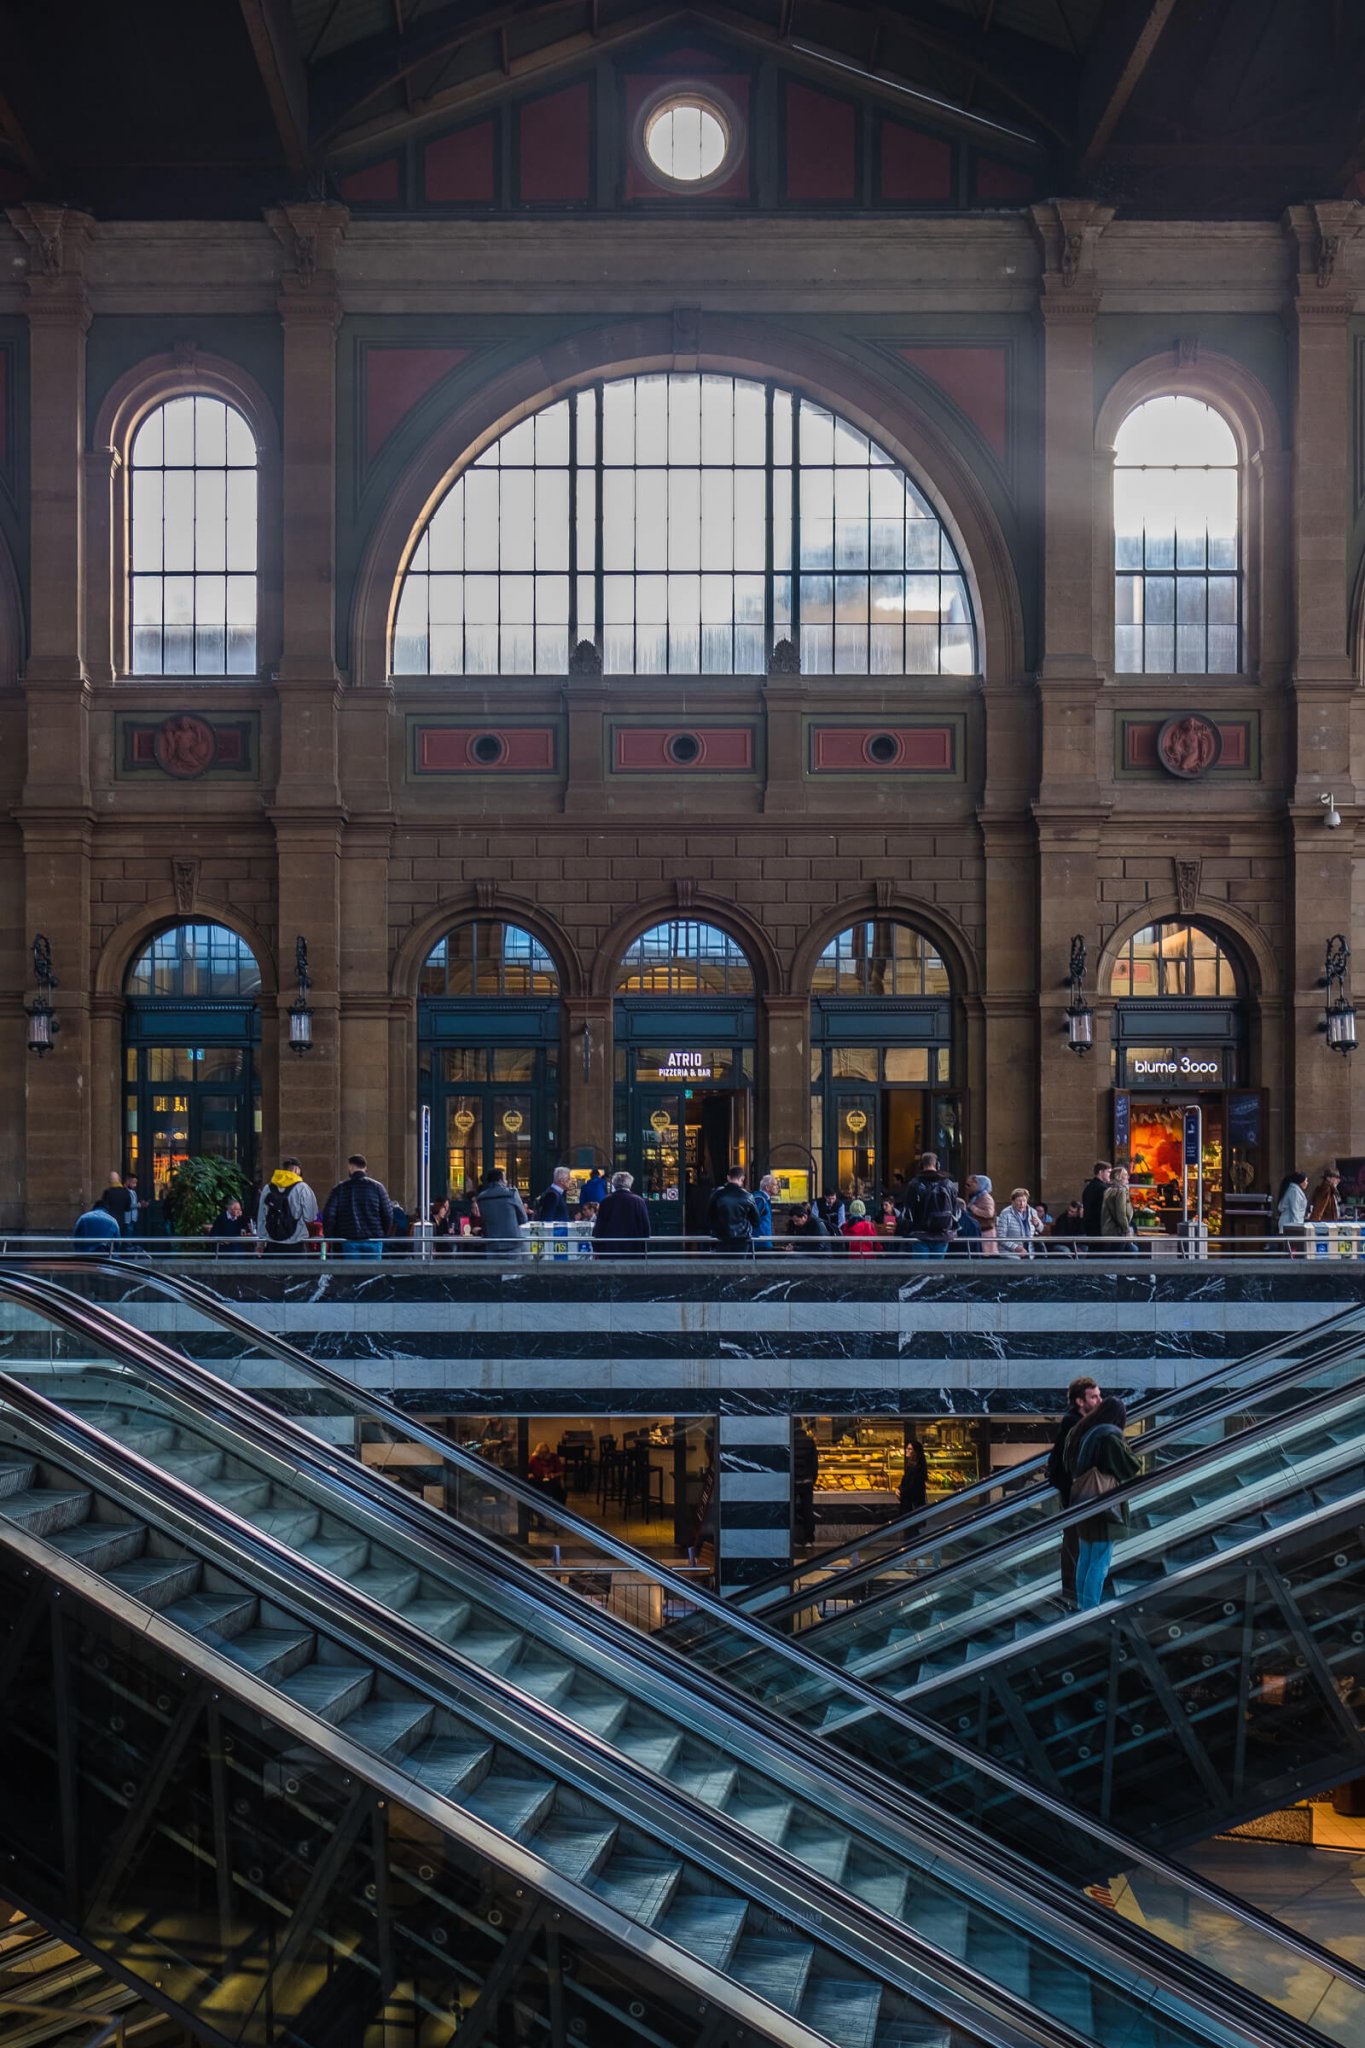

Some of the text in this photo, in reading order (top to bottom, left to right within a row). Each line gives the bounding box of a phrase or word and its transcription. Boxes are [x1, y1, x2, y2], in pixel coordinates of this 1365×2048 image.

[668, 1053, 702, 1066] ATRIO
[658, 1068, 711, 1077] PIZZERIA & BAR
[1135, 1060, 1178, 1073] blume
